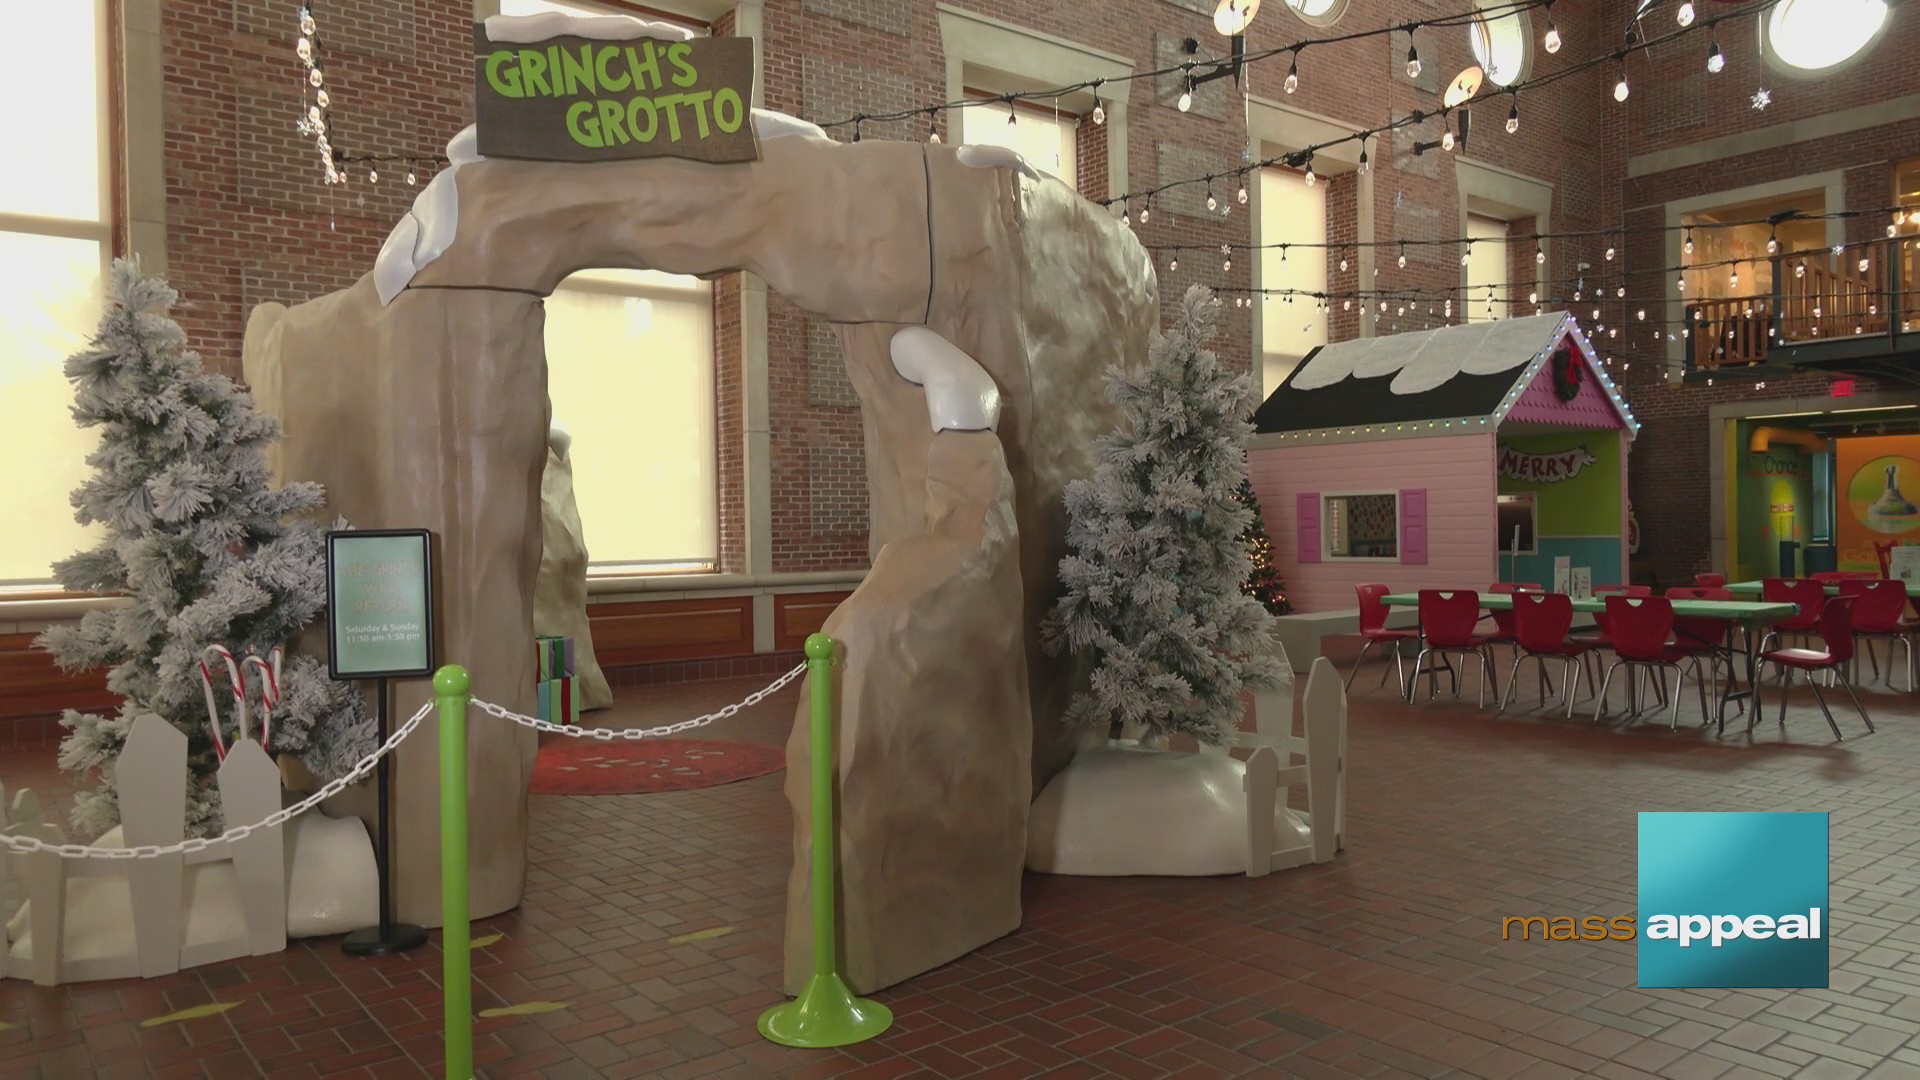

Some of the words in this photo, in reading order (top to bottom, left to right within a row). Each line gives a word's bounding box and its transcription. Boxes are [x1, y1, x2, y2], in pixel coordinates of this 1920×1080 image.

[485, 40, 698, 99] GRINCH'S
[566, 87, 744, 148] GROTTO
[1498, 449, 1576, 479] MERRY
[346, 624, 380, 634] Saturday
[382, 624, 389, 632] &
[390, 622, 420, 632] Sunday
